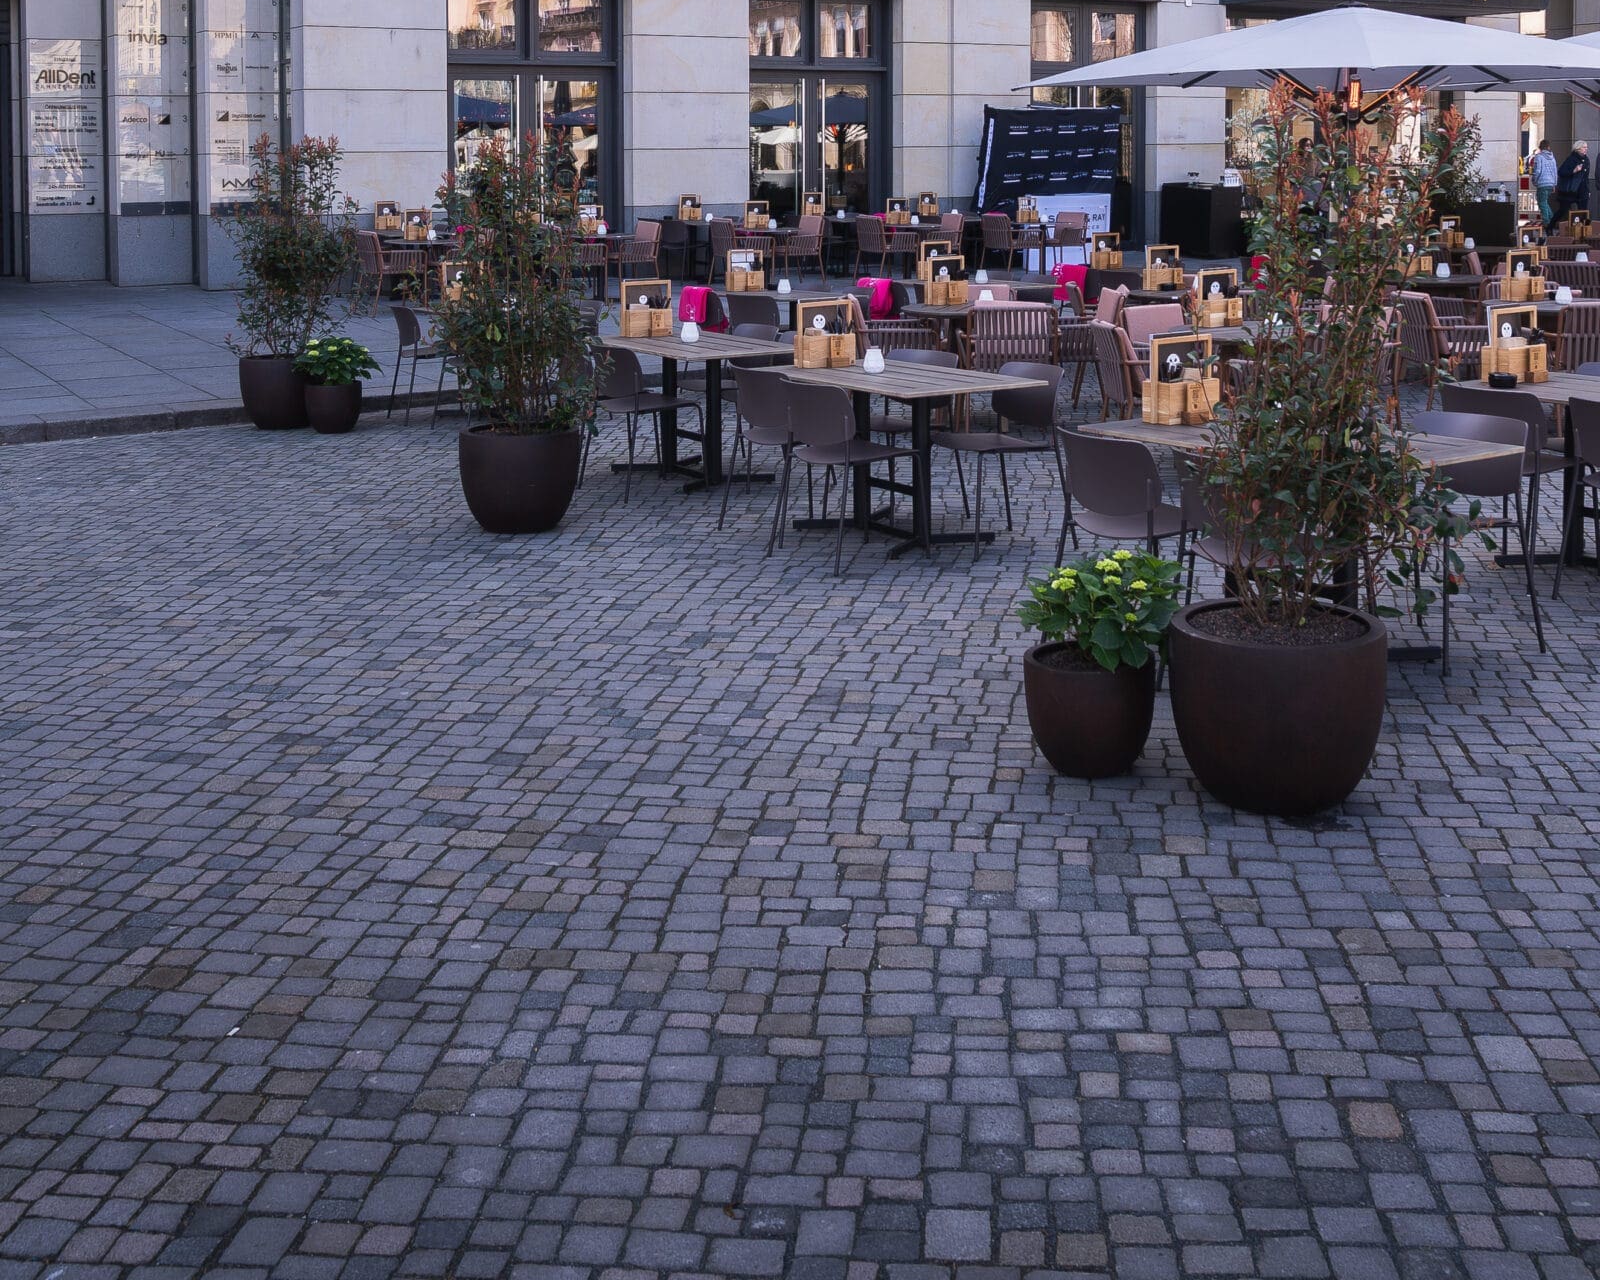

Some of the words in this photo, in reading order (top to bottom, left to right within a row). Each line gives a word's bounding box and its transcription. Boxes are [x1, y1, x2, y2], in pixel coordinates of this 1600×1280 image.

[128, 29, 167, 46] invia
[216, 62, 238, 74] Regus
[35, 69, 96, 85] AllDent
